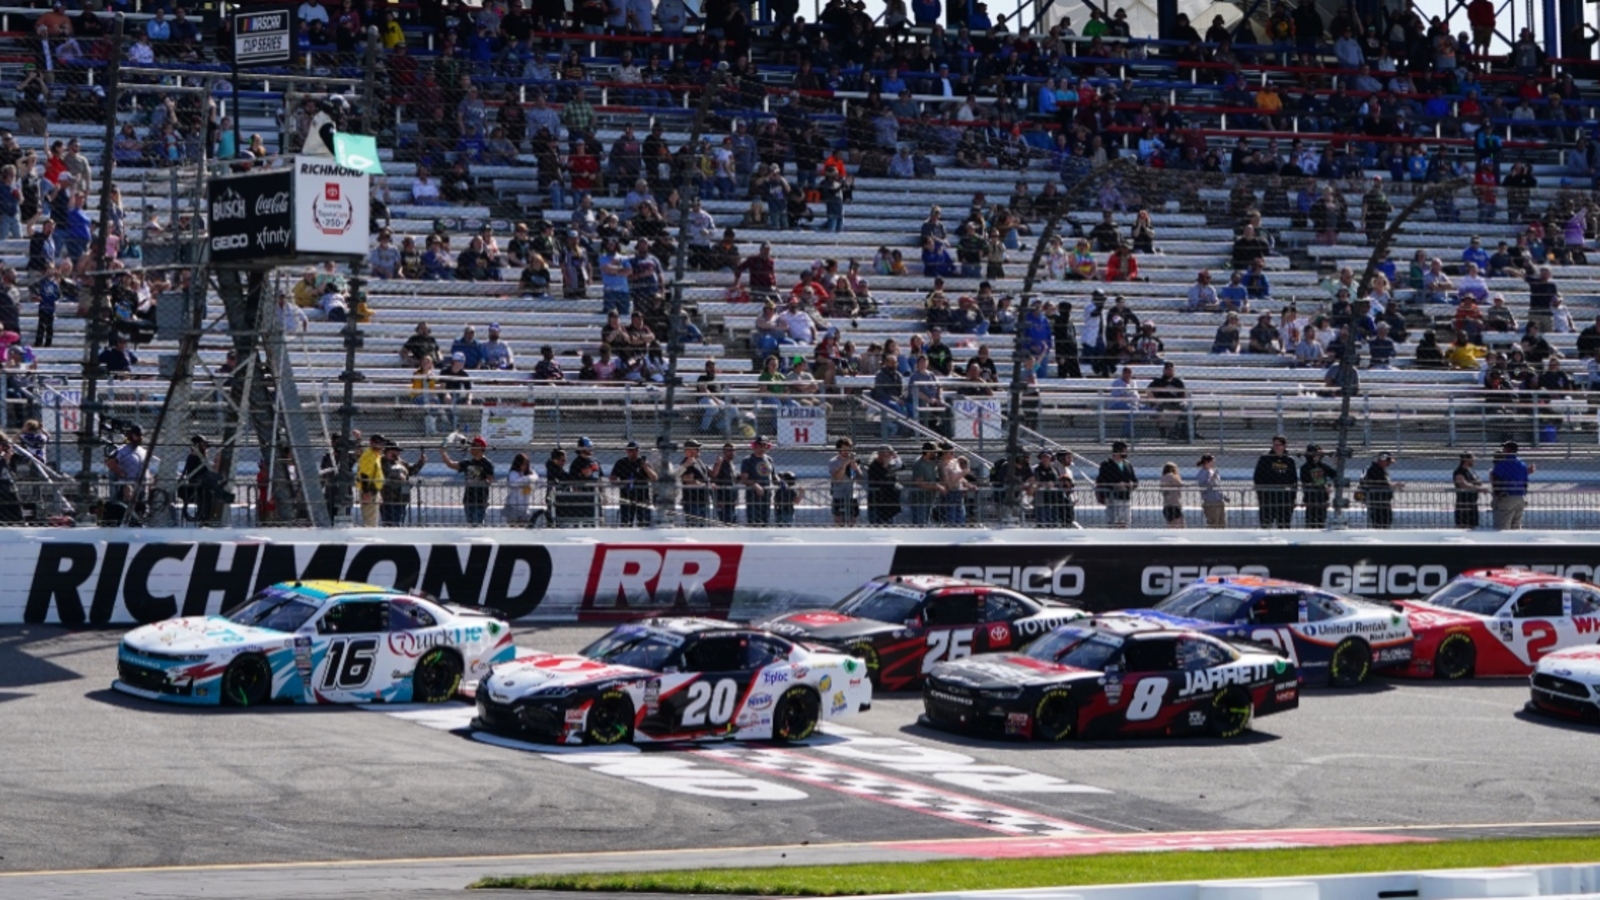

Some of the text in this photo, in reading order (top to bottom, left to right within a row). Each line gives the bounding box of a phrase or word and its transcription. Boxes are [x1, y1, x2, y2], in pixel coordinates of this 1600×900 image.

[212, 199, 246, 221] BUSCH
[212, 233, 249, 251] GEICO
[256, 226, 291, 250] xfinity
[794, 427, 809, 443] H
[592, 549, 721, 608] RR
[1321, 564, 1448, 596] GEICO
[1318, 620, 1388, 635] United Rentals
[1521, 619, 1558, 664] 2
[320, 636, 380, 691] 16
[681, 677, 738, 727] 20
[1125, 676, 1169, 721] 8
